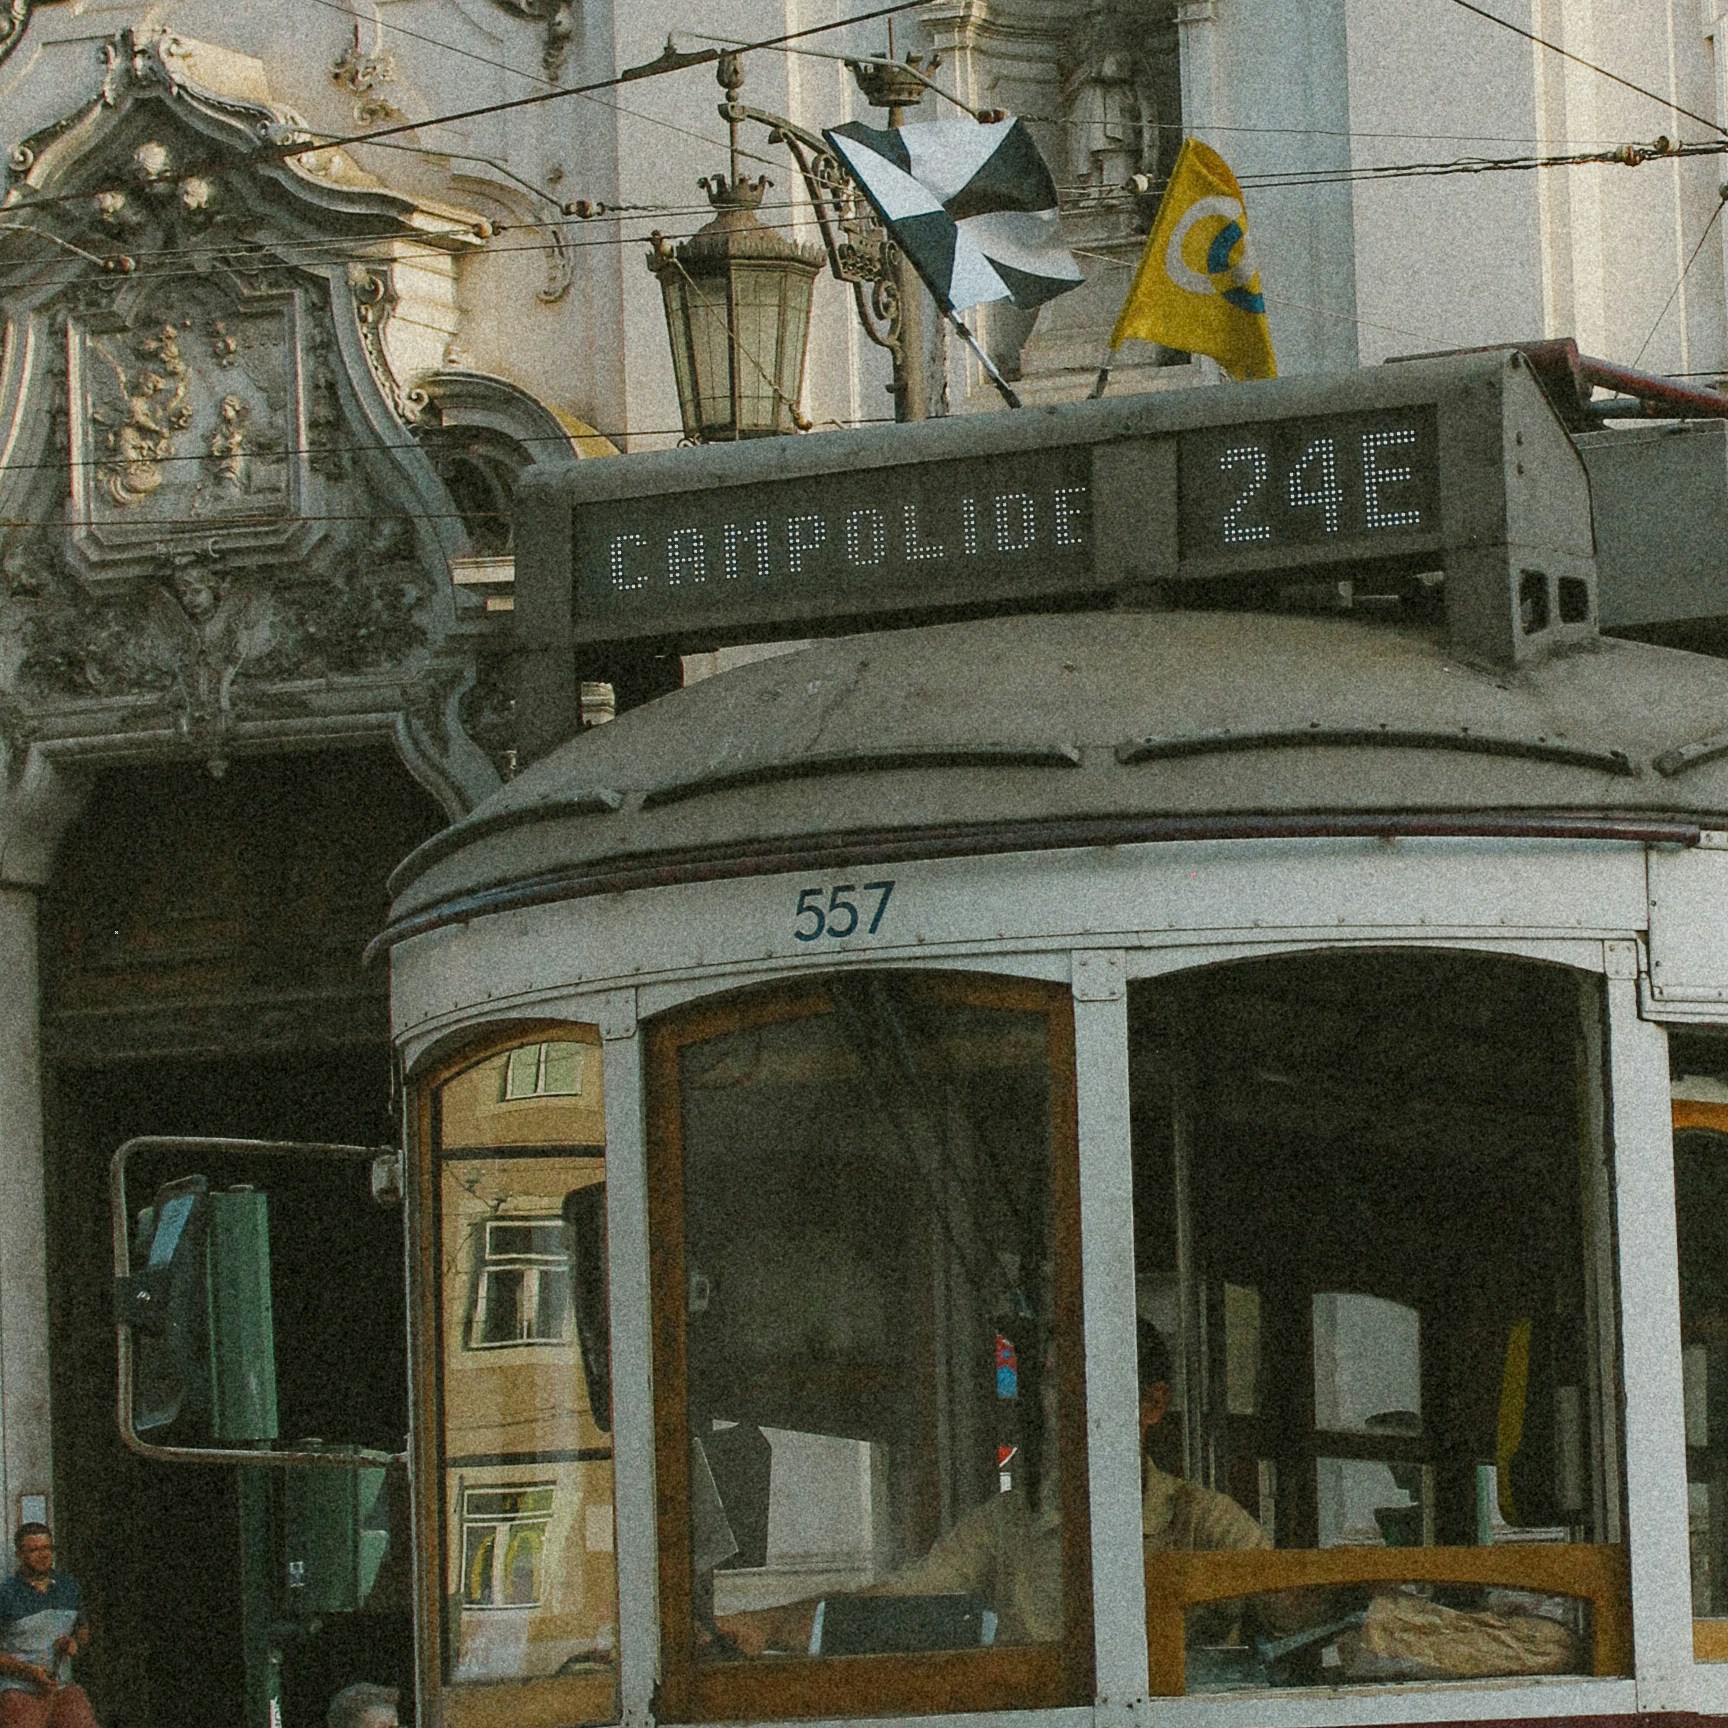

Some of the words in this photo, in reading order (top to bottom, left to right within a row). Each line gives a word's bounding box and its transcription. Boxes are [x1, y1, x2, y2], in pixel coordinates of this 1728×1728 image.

[1218, 428, 1422, 543] 24E
[610, 486, 1087, 591] CAMPOLIDE
[793, 880, 896, 942] 557
